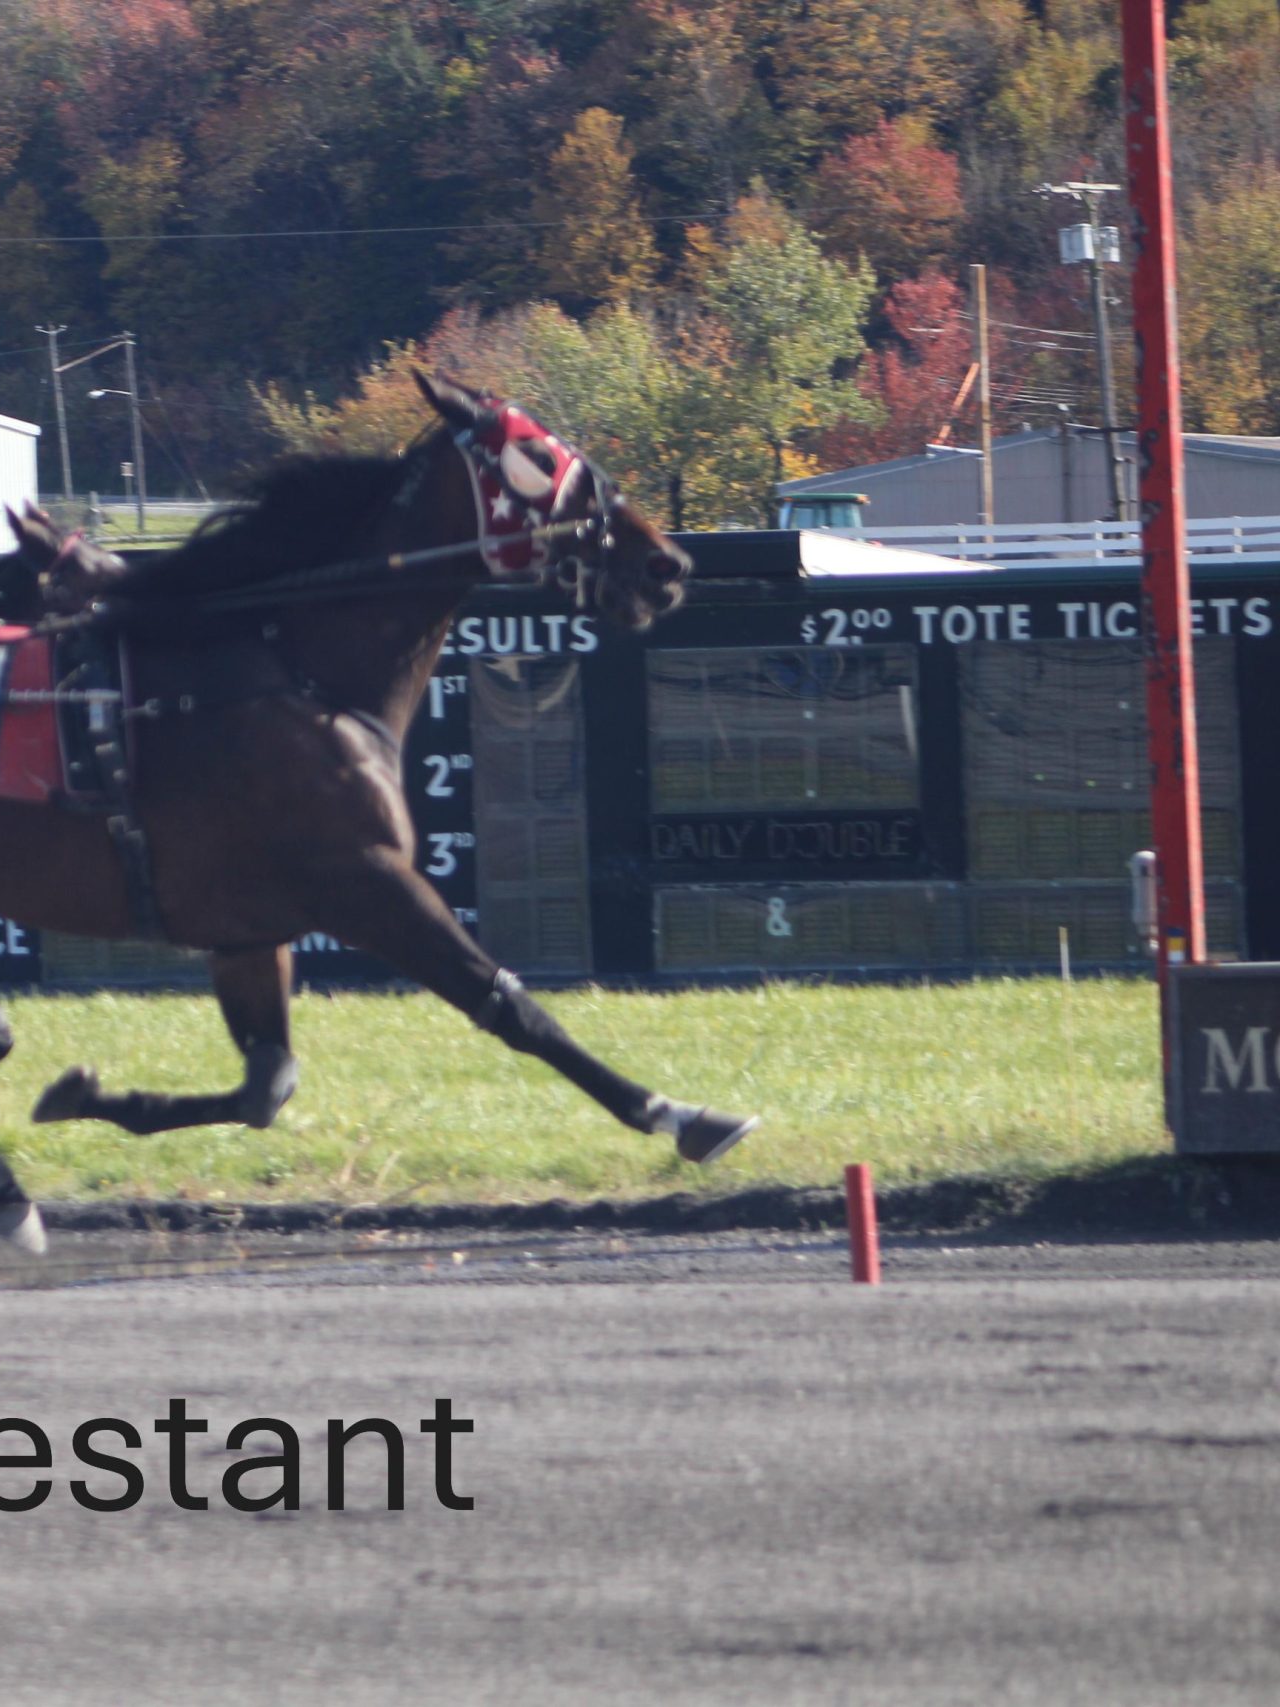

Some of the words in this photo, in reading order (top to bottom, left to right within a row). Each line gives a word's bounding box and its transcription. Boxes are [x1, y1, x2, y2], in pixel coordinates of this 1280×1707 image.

[437, 614, 599, 655] ESULTS
[913, 604, 1031, 645] TOTE
[1057, 597, 1273, 641] TICETS
[765, 896, 793, 937] &
[1199, 1026, 1280, 1094] M
